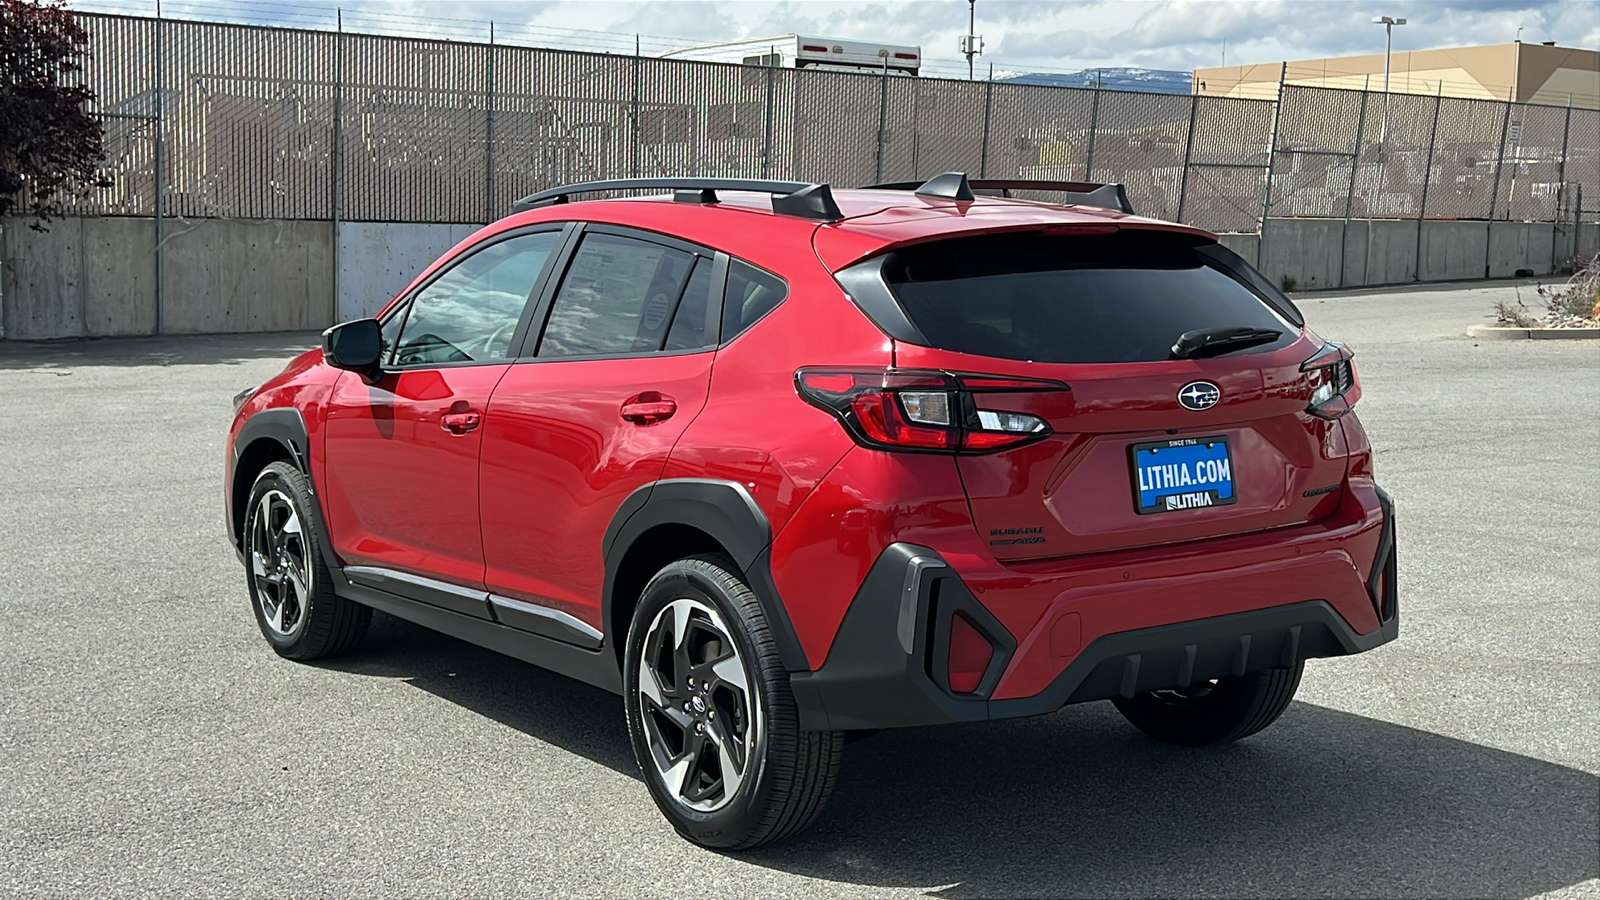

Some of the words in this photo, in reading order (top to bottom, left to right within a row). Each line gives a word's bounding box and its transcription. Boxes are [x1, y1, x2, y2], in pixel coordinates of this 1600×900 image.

[1138, 458, 1231, 491] LITHIA.COM
[1176, 491, 1213, 509] LITHIA
[990, 527, 1042, 535] SUBARU
